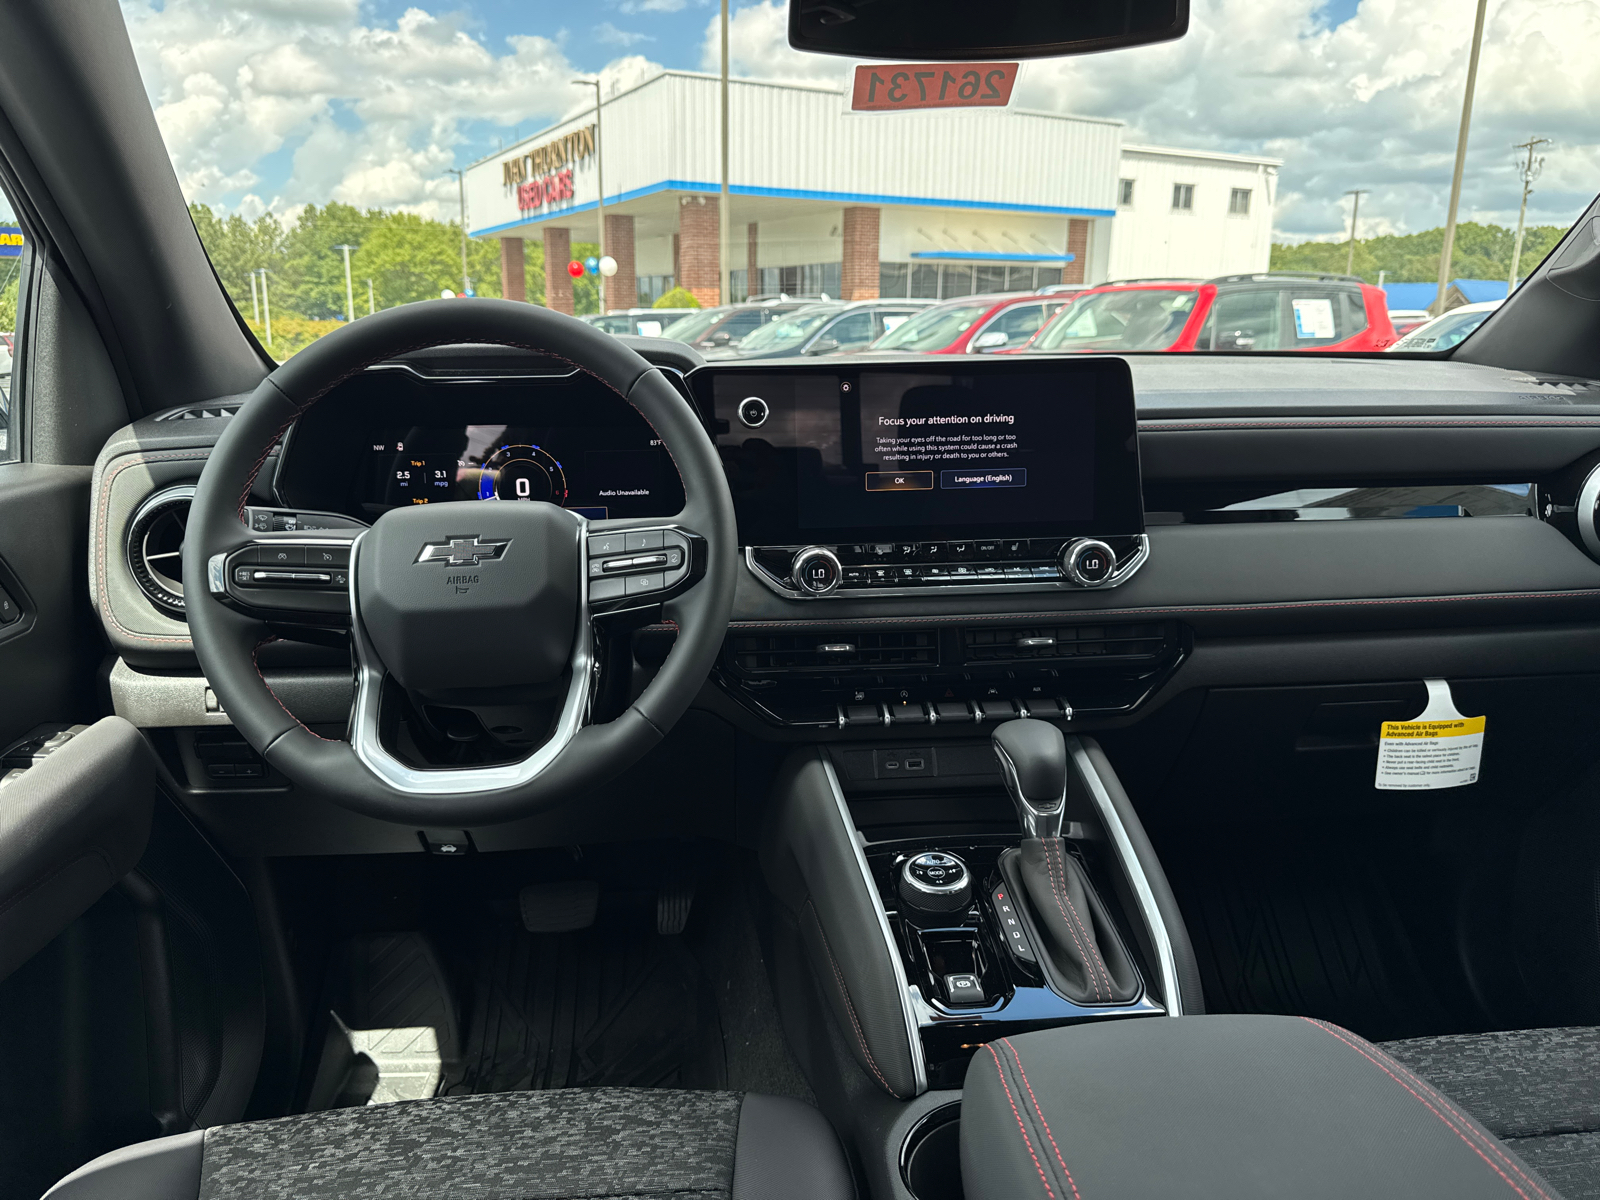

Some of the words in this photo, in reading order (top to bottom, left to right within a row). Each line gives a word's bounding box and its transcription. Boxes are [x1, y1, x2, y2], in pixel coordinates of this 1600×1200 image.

[543, 168, 574, 204] CARS
[878, 416, 904, 426] Focus
[906, 417, 926, 427] your
[928, 415, 968, 424] attention
[984, 413, 1015, 424] driving
[516, 478, 530, 496] 0
[447, 575, 479, 585] AIRBAG
